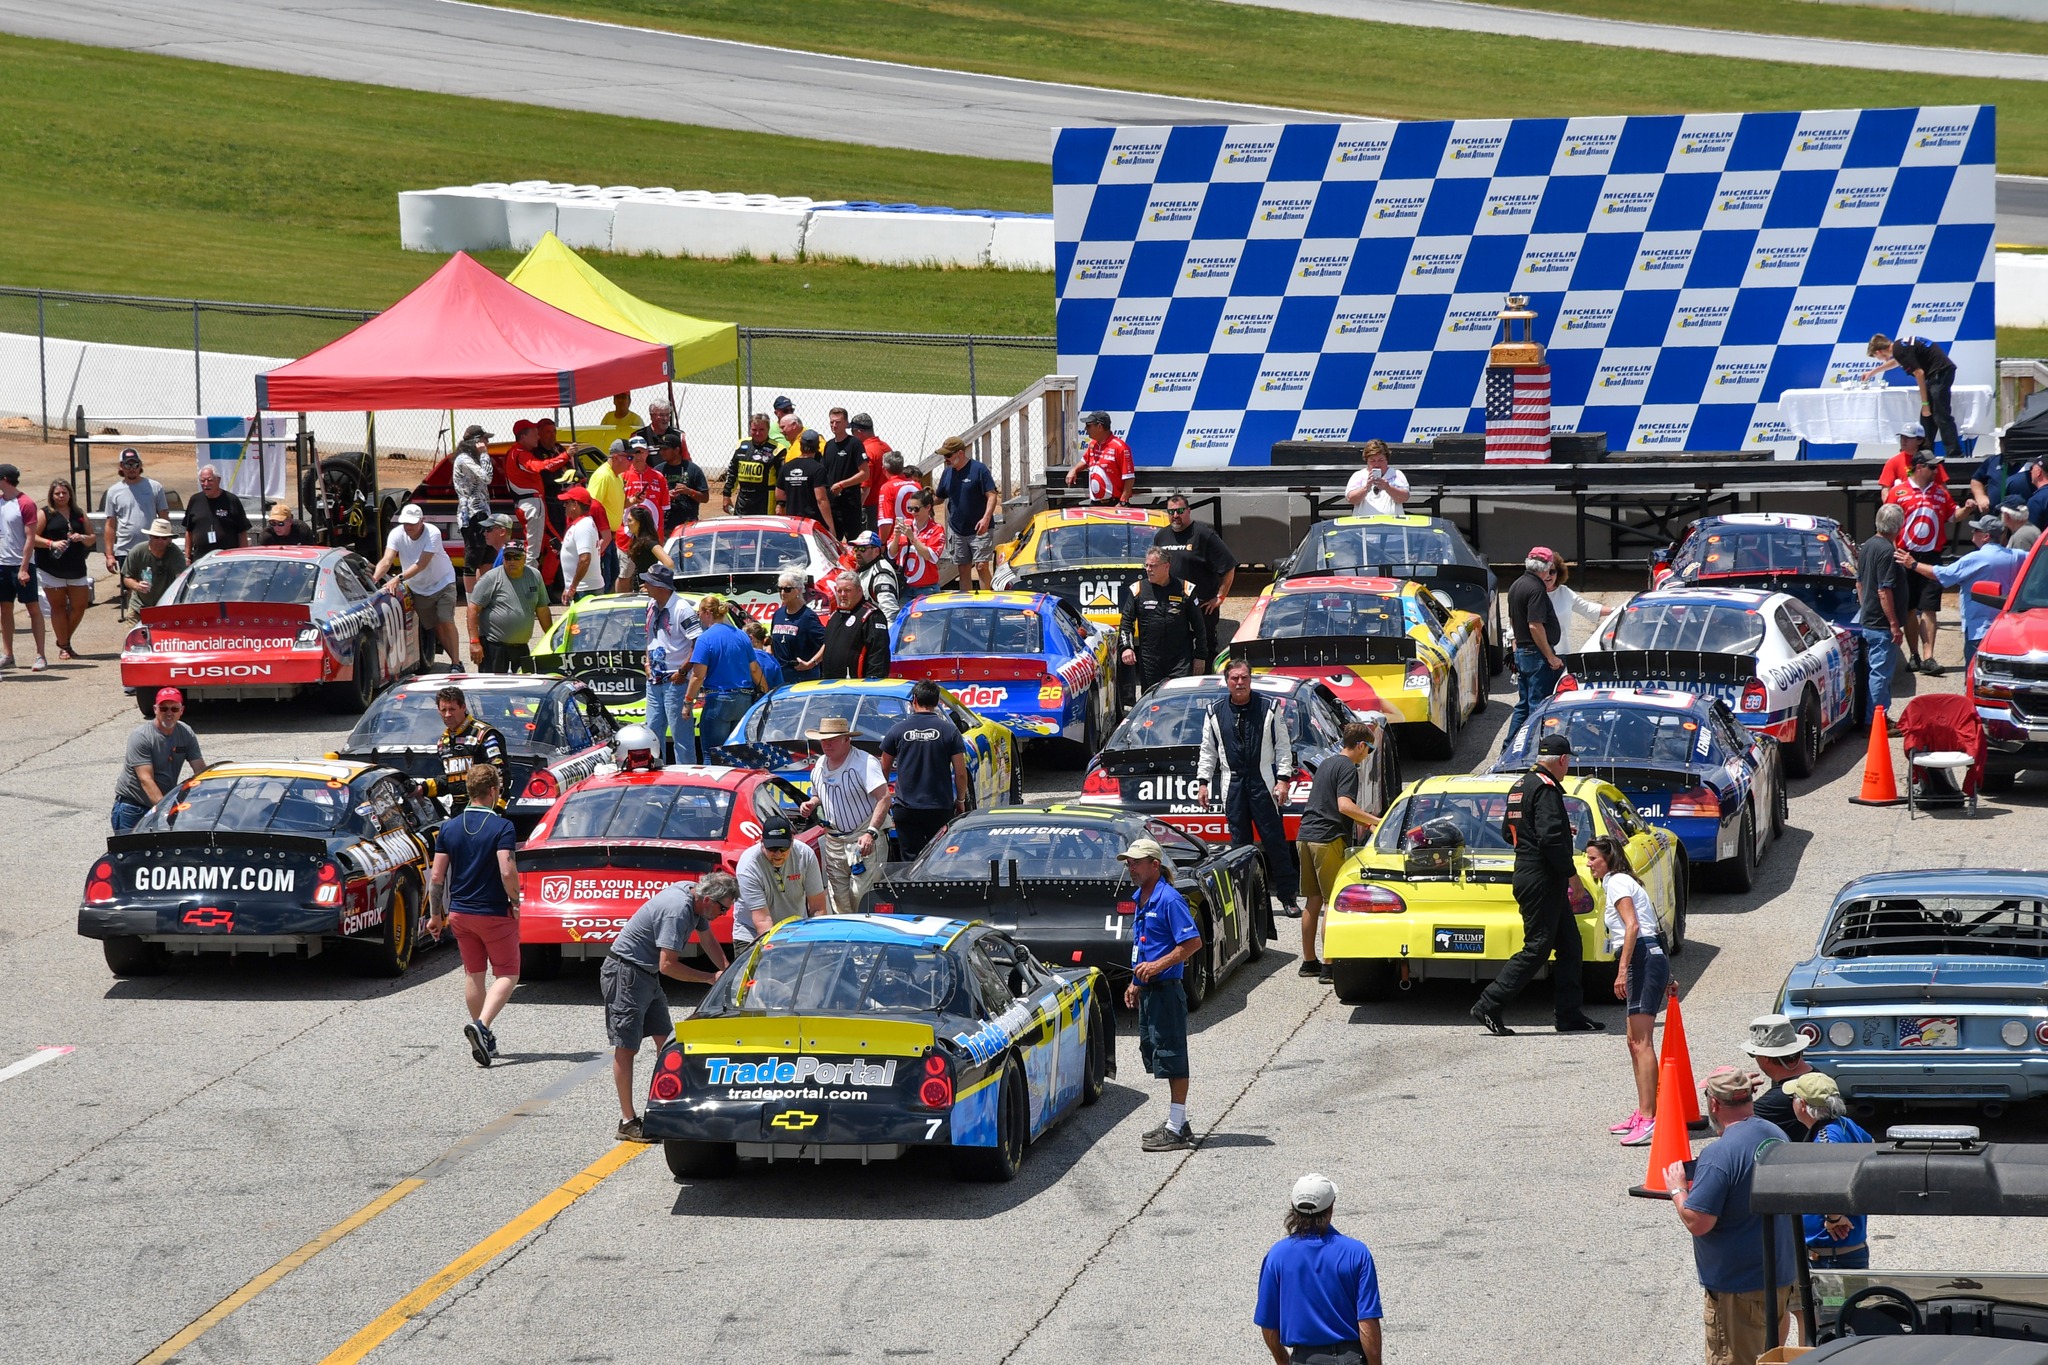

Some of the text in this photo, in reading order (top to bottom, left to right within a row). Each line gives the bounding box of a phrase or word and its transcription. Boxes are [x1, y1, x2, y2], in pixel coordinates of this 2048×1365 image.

[1570, 147, 1609, 156] Road Atlanta
[1116, 156, 1154, 165] Road Atlanta
[1342, 152, 1380, 162] Road Atlanta
[1379, 209, 1417, 218] Road Atlanta
[1607, 204, 1647, 214] Road Atlanta
[1154, 212, 1191, 222] Road Atlanta
[1645, 261, 1684, 270] Road Atlanta
[1191, 269, 1229, 278] Road Atlanta
[1416, 266, 1455, 276] Road Atlanta
[1682, 318, 1721, 328] Road Atlanta
[1228, 326, 1266, 334] Road Atlanta
[1265, 382, 1302, 391] Road Atlanta
[1604, 377, 1644, 387] Road Atlanta
[1190, 439, 1228, 448] Road Atlanta
[1080, 581, 1122, 606] CAT
[300, 629, 318, 641] 90
[153, 636, 294, 652] citifinancialracing.com
[559, 652, 647, 670] Hoosie
[170, 665, 272, 678] FUSION
[588, 678, 635, 692] Ansell
[1408, 676, 1428, 686] 38
[1038, 686, 1062, 699] 26
[1745, 694, 1762, 708] 33
[1170, 804, 1206, 813] Mobi
[1636, 804, 1664, 818] call.
[989, 826, 1084, 836] NEMECHEK
[135, 866, 295, 892] GOARMY.COM
[574, 880, 674, 889] SEE YOUR LOCA
[318, 887, 337, 902] 01
[574, 890, 620, 899] DODGE
[344, 906, 382, 936] CENTRIX
[562, 918, 628, 928] DODG
[1105, 915, 1123, 940] 4
[1453, 934, 1484, 942] TRUMP
[1454, 942, 1482, 951] MAGA
[704, 1056, 898, 1087] TradePortal
[728, 1087, 868, 1101] tradeportal.com
[925, 1118, 943, 1140] 7
